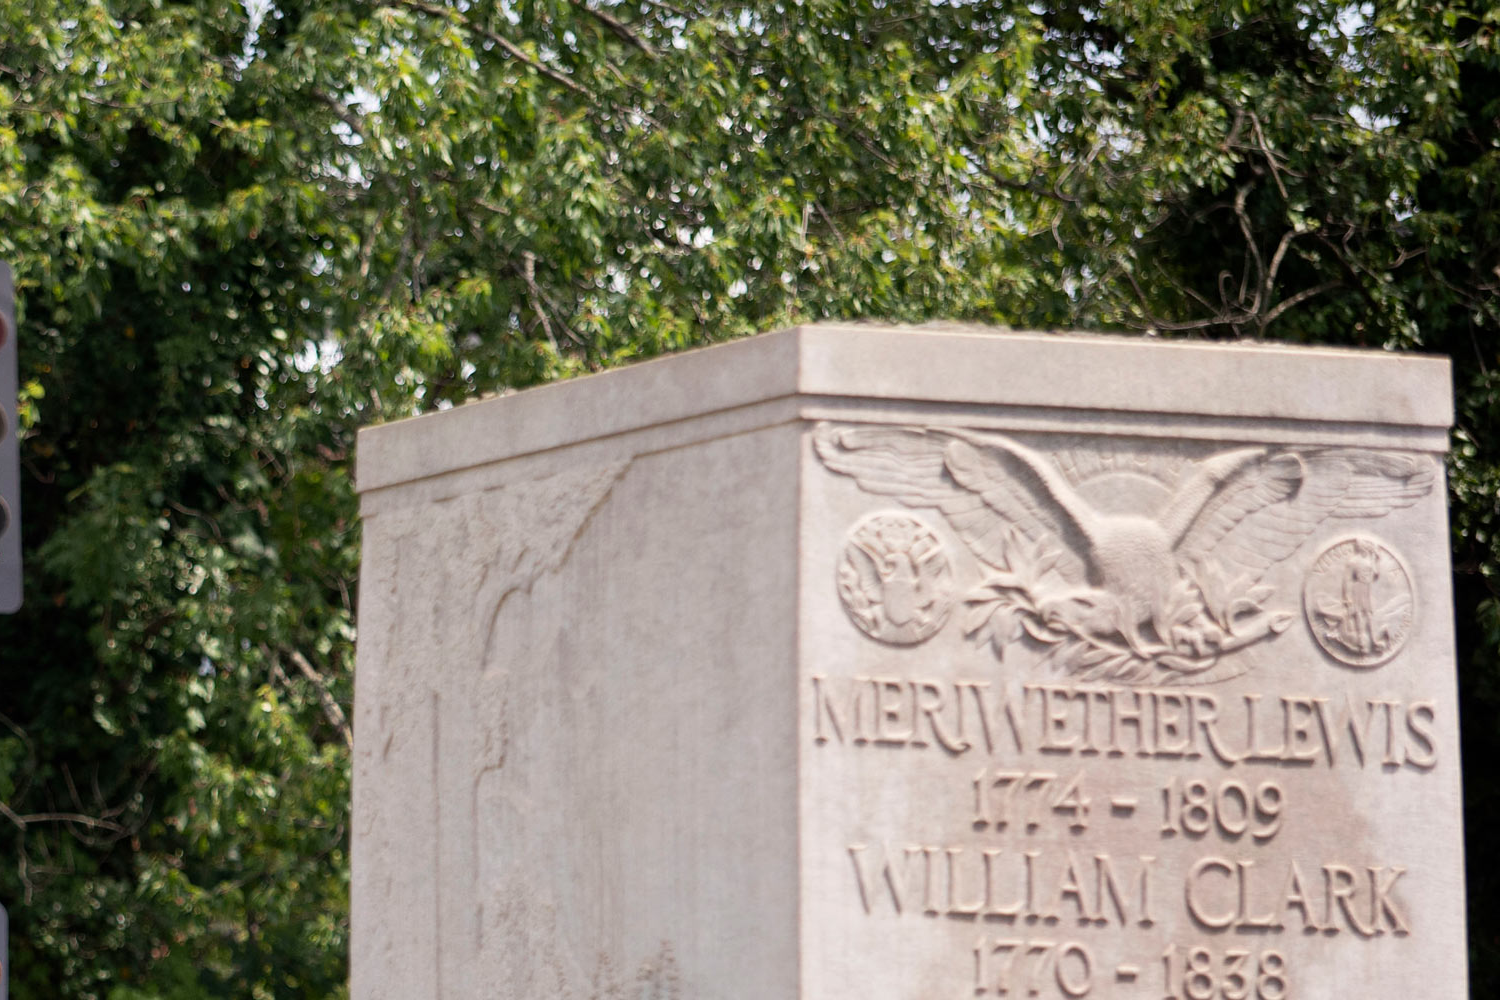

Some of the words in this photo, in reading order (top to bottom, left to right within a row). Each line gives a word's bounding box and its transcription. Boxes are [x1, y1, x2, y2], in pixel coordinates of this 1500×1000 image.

[812, 673, 1237, 767] MERIWETHER
[1242, 693, 1438, 770] LEWIS
[972, 767, 1092, 835] 1774
[1160, 775, 1284, 844] 1809
[847, 842, 1156, 928] WILLIAM
[1185, 855, 1409, 939] CLARK
[973, 935, 1094, 1000] 1770
